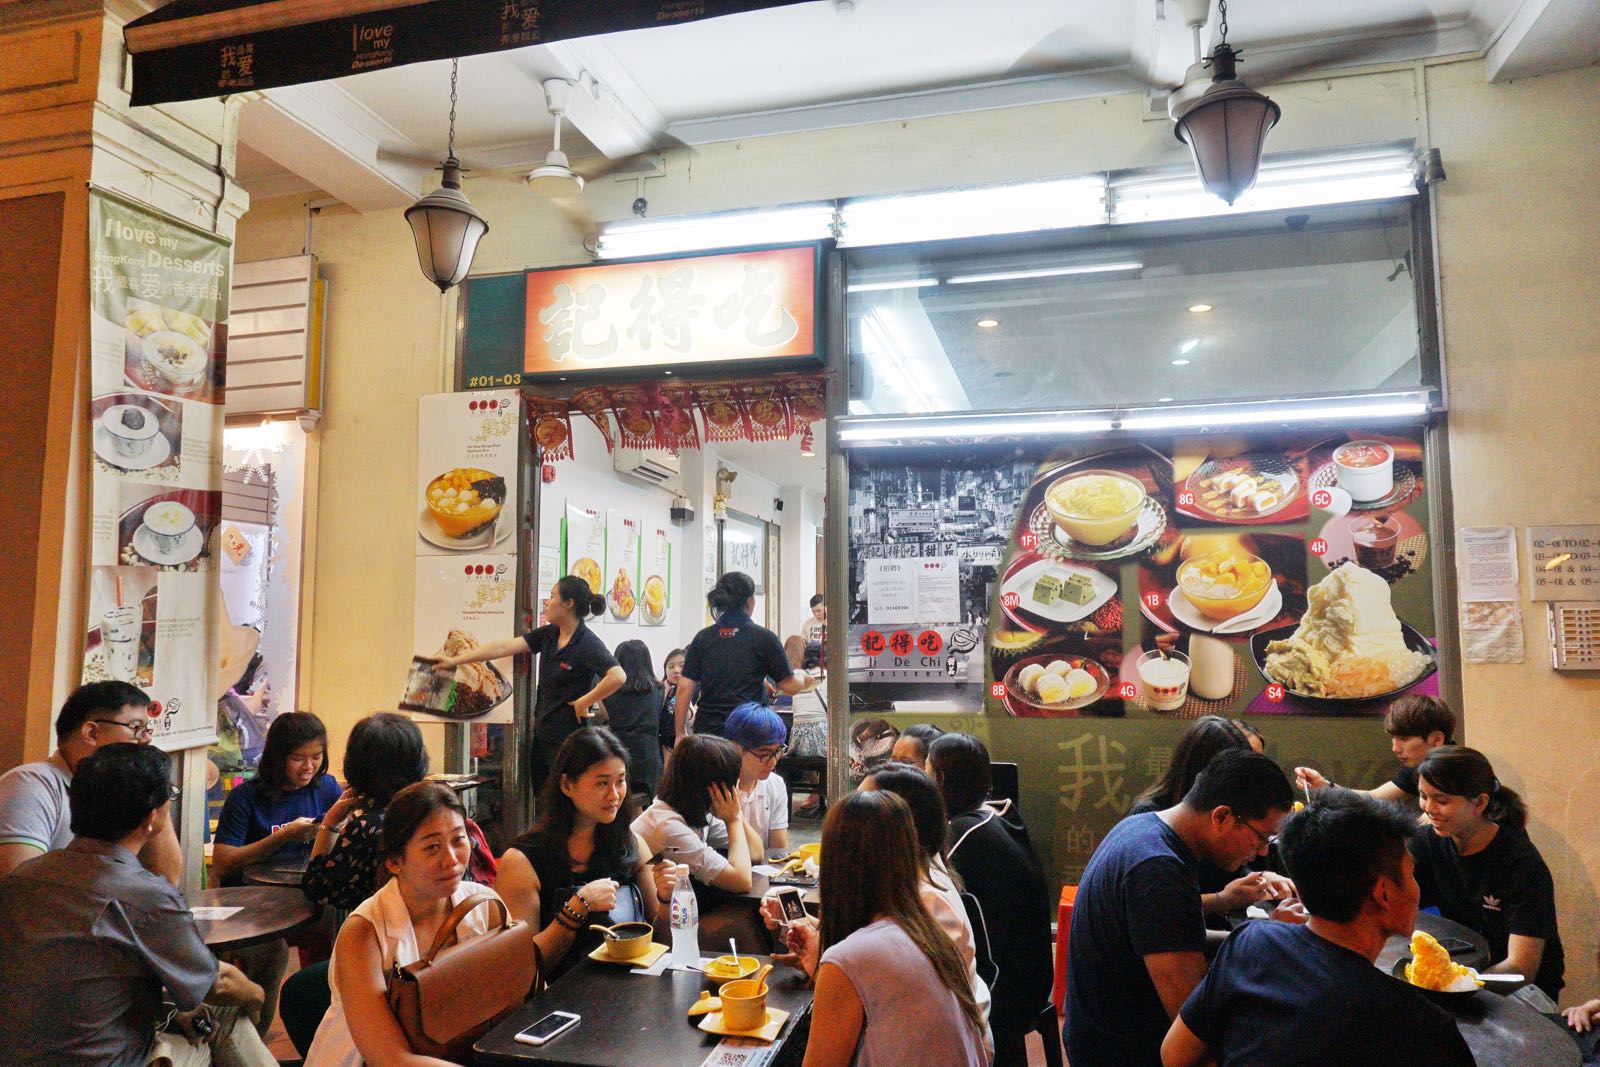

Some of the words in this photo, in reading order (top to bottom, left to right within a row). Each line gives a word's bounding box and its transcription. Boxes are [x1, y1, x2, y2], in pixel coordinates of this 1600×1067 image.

[360, 25, 393, 41] love
[373, 38, 391, 49] my
[112, 221, 157, 245] love
[159, 236, 179, 250] my
[147, 249, 225, 277] Desserts
[538, 264, 798, 362] 記得吃
[469, 373, 521, 388] #01-03
[1179, 493, 1194, 505] 8G
[1314, 492, 1330, 505] 5C
[1021, 536, 1037, 547] 1F1
[870, 541, 955, 558] 記得吃甜品
[1311, 542, 1326, 554] 4H
[1004, 593, 1020, 606] 8M
[1146, 595, 1160, 606] 1B
[862, 633, 938, 654] 記得吃
[869, 657, 877, 668] Ji
[894, 657, 910, 667] De
[920, 656, 941, 667] Chi
[992, 685, 1005, 696] 8B
[1120, 685, 1135, 697] 4G
[1268, 686, 1282, 698] S4
